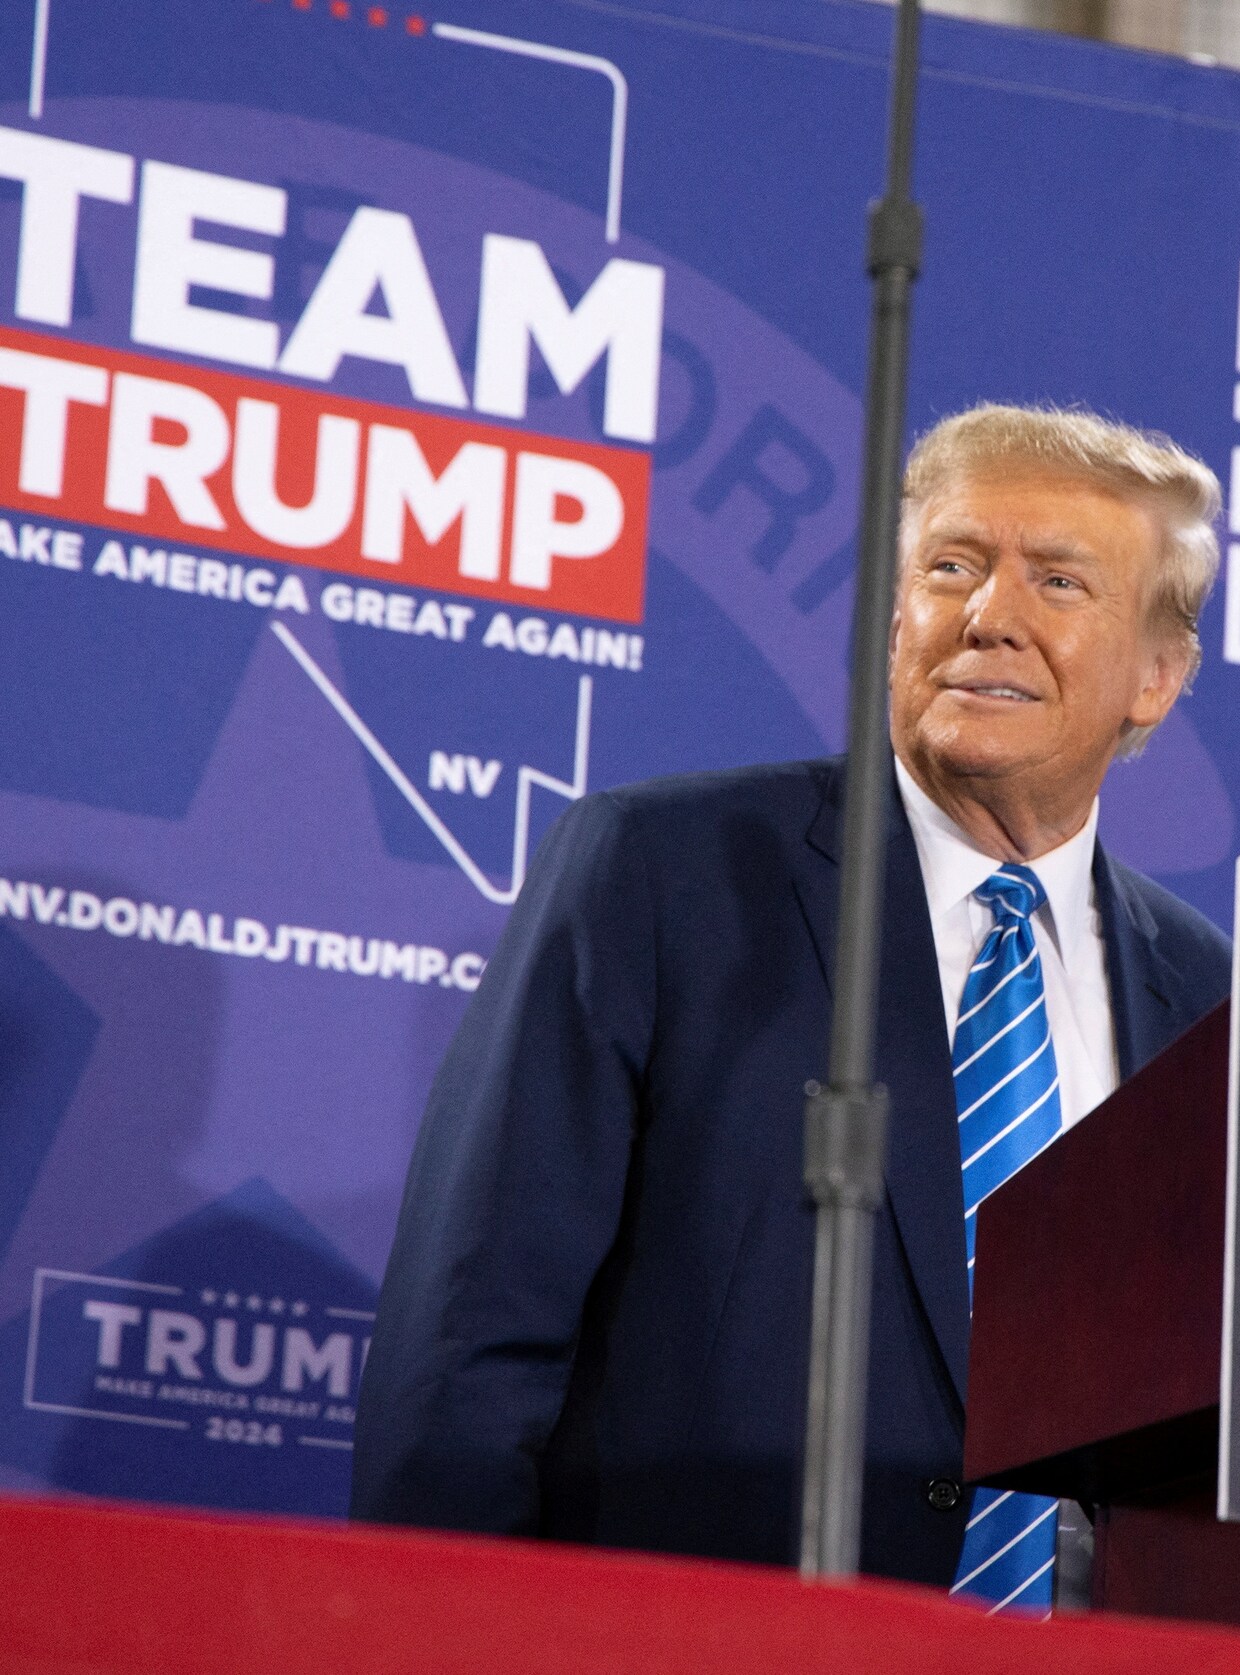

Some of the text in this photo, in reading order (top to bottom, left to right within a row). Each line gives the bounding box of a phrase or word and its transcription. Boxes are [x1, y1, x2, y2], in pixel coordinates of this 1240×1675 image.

[0, 126, 664, 443] TEAM
[0, 347, 624, 589] TRUMP
[92, 540, 310, 614] AMERICA
[320, 582, 474, 642] GREAT
[482, 613, 643, 671] AGAIN!
[428, 750, 502, 798] NV
[0, 878, 487, 992] NV.DONALDJTRUMP.C
[83, 1300, 371, 1397] TRUM
[205, 1415, 283, 1448] 2024
